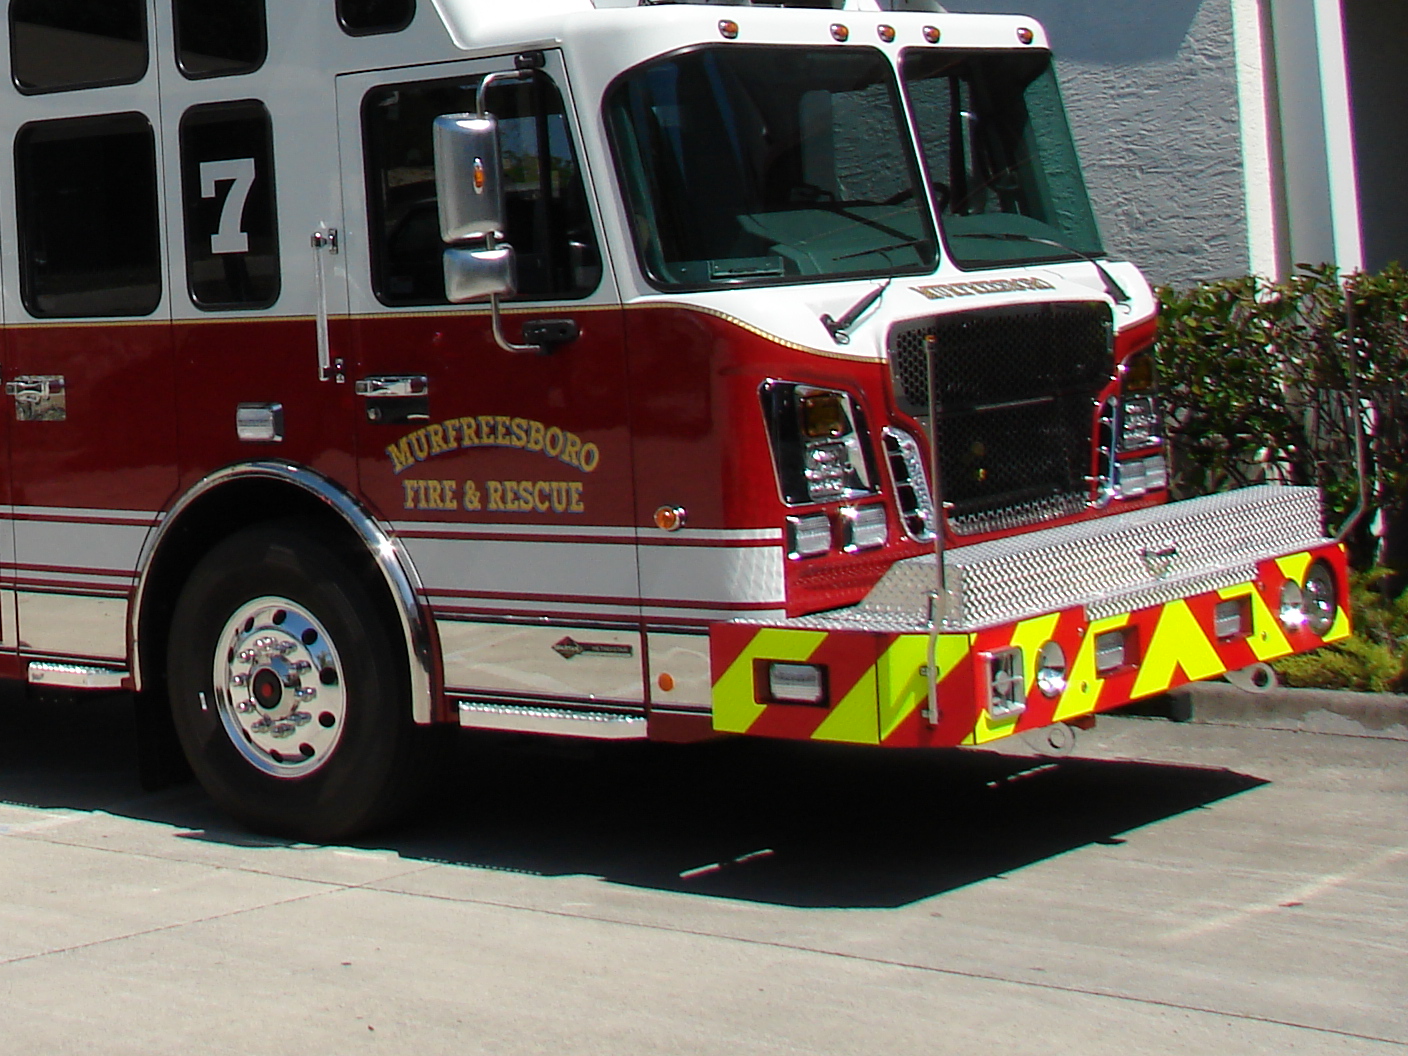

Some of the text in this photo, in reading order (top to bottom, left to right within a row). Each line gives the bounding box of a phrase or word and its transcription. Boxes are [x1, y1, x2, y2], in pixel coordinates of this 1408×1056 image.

[199, 157, 255, 254] 7
[385, 415, 600, 474] MURFREESBORO
[403, 479, 584, 513] FIRE & RESCUE
